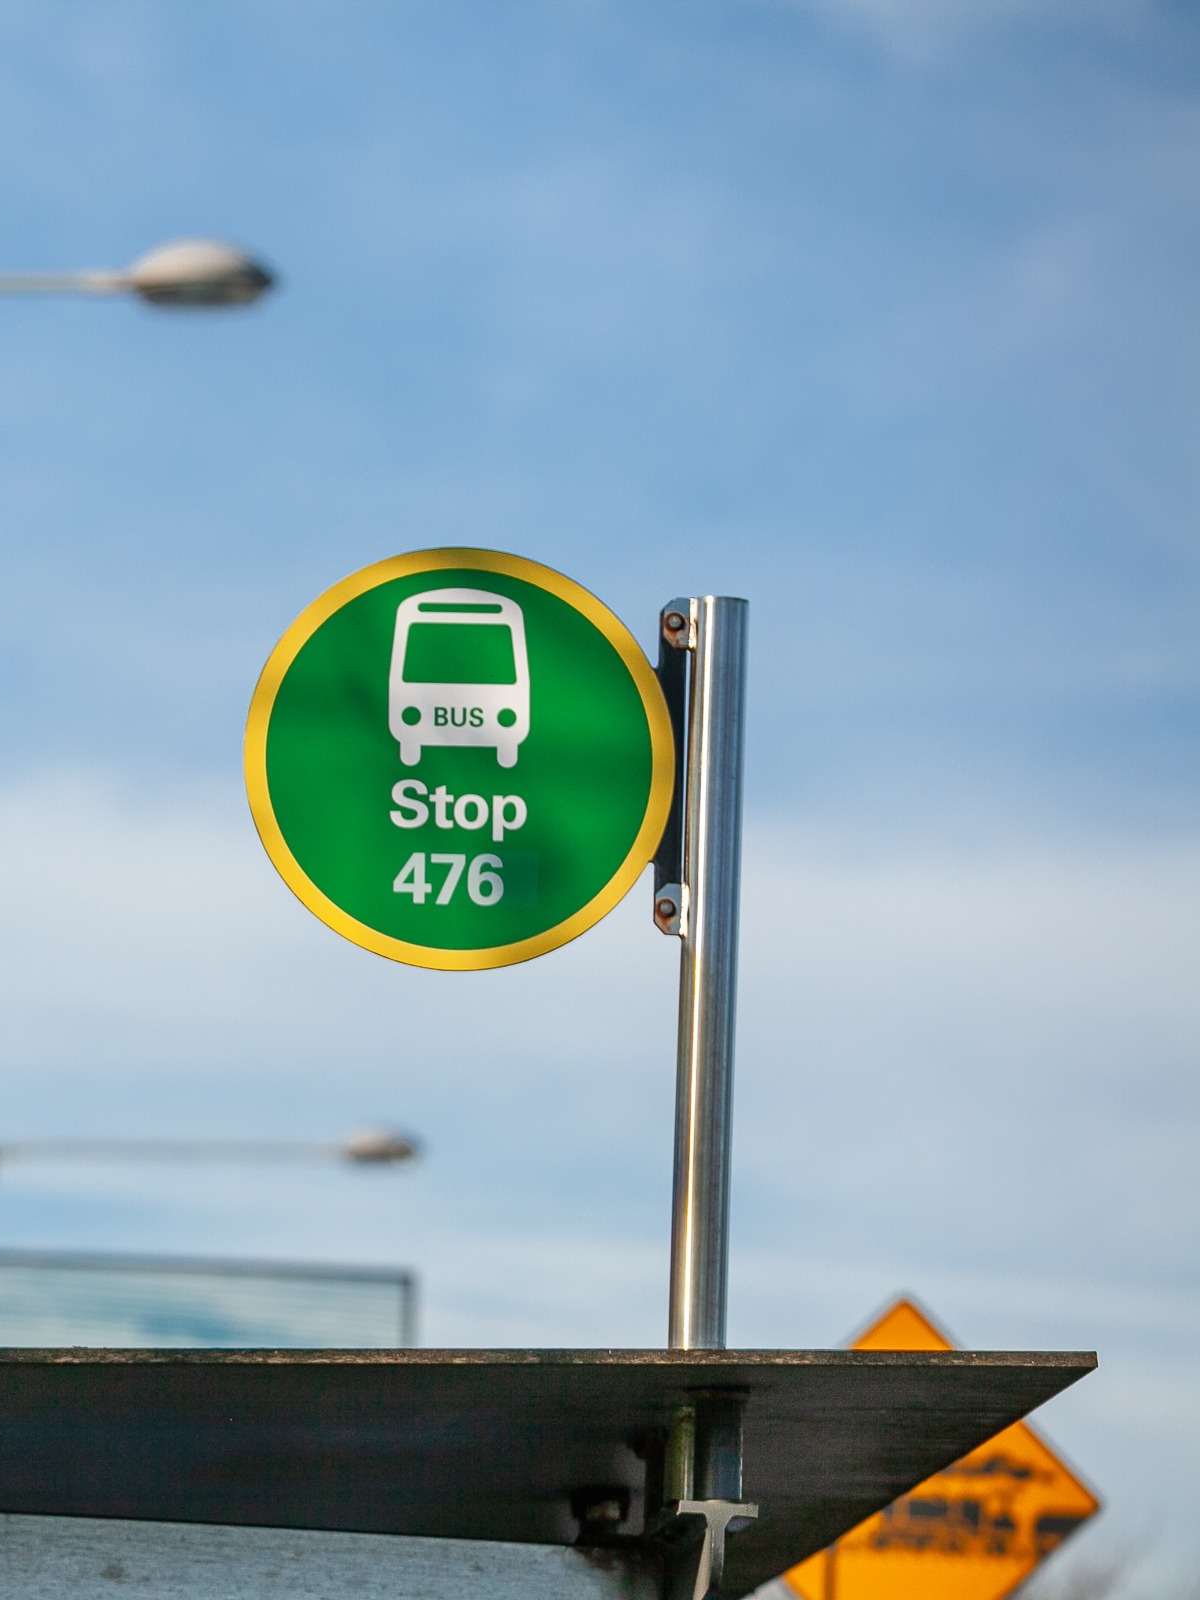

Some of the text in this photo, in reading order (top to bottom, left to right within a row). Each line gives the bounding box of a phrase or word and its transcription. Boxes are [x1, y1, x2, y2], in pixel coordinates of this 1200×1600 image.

[434, 707, 484, 728] BUS
[389, 779, 528, 842] Stop
[393, 852, 504, 907] 476
